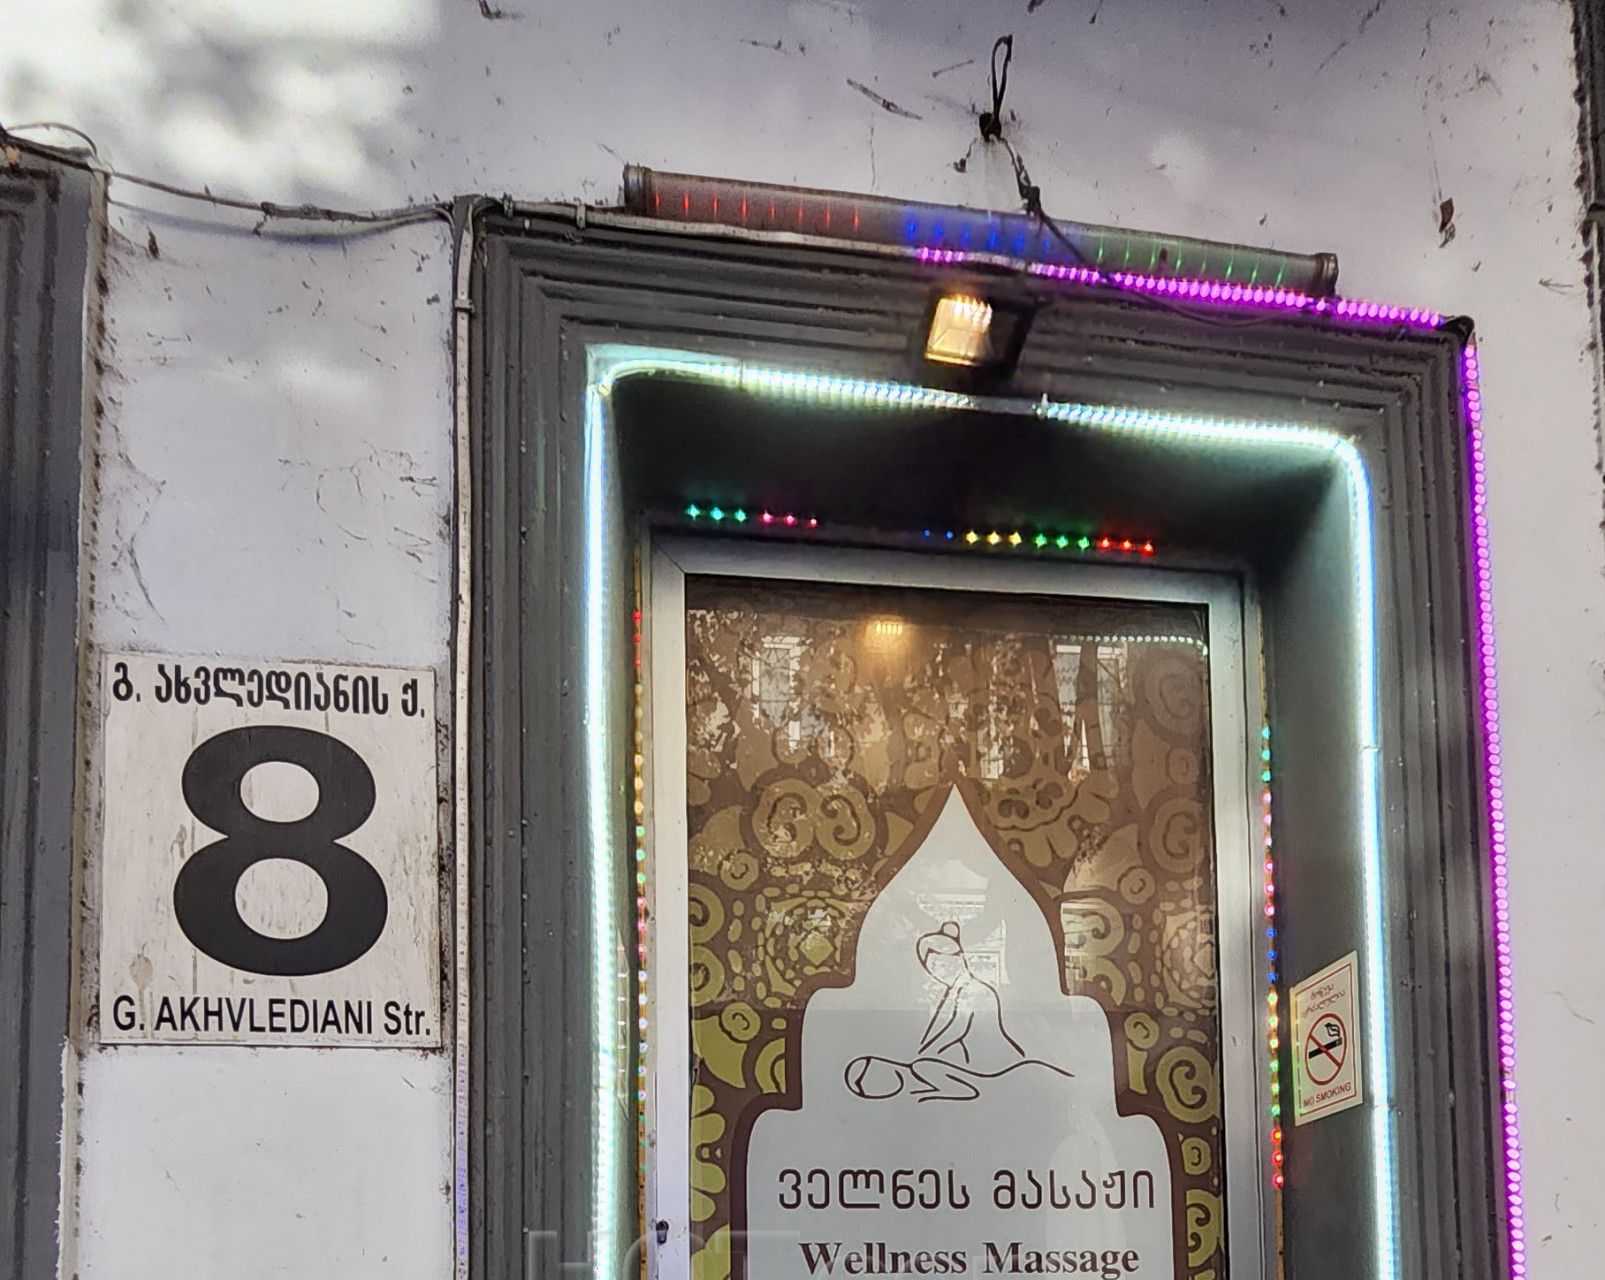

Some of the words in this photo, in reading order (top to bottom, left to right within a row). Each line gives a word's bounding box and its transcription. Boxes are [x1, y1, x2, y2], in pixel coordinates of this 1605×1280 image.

[112, 661, 141, 702] გ.
[155, 663, 389, 715] ახვლედიანის
[401, 678, 425, 718] ქ.
[173, 725, 388, 977] 8
[113, 995, 144, 1032] G.
[155, 996, 373, 1034] AKHVLEDIANI
[384, 1000, 431, 1036] Str.
[1303, 1096, 1314, 1108] NO
[1315, 1082, 1352, 1103] SMOKING
[778, 1168, 970, 1209] ველნეს
[993, 1168, 1155, 1209] მასაჟი
[798, 1242, 967, 1275] Wellness
[982, 1242, 1140, 1280] Massage
